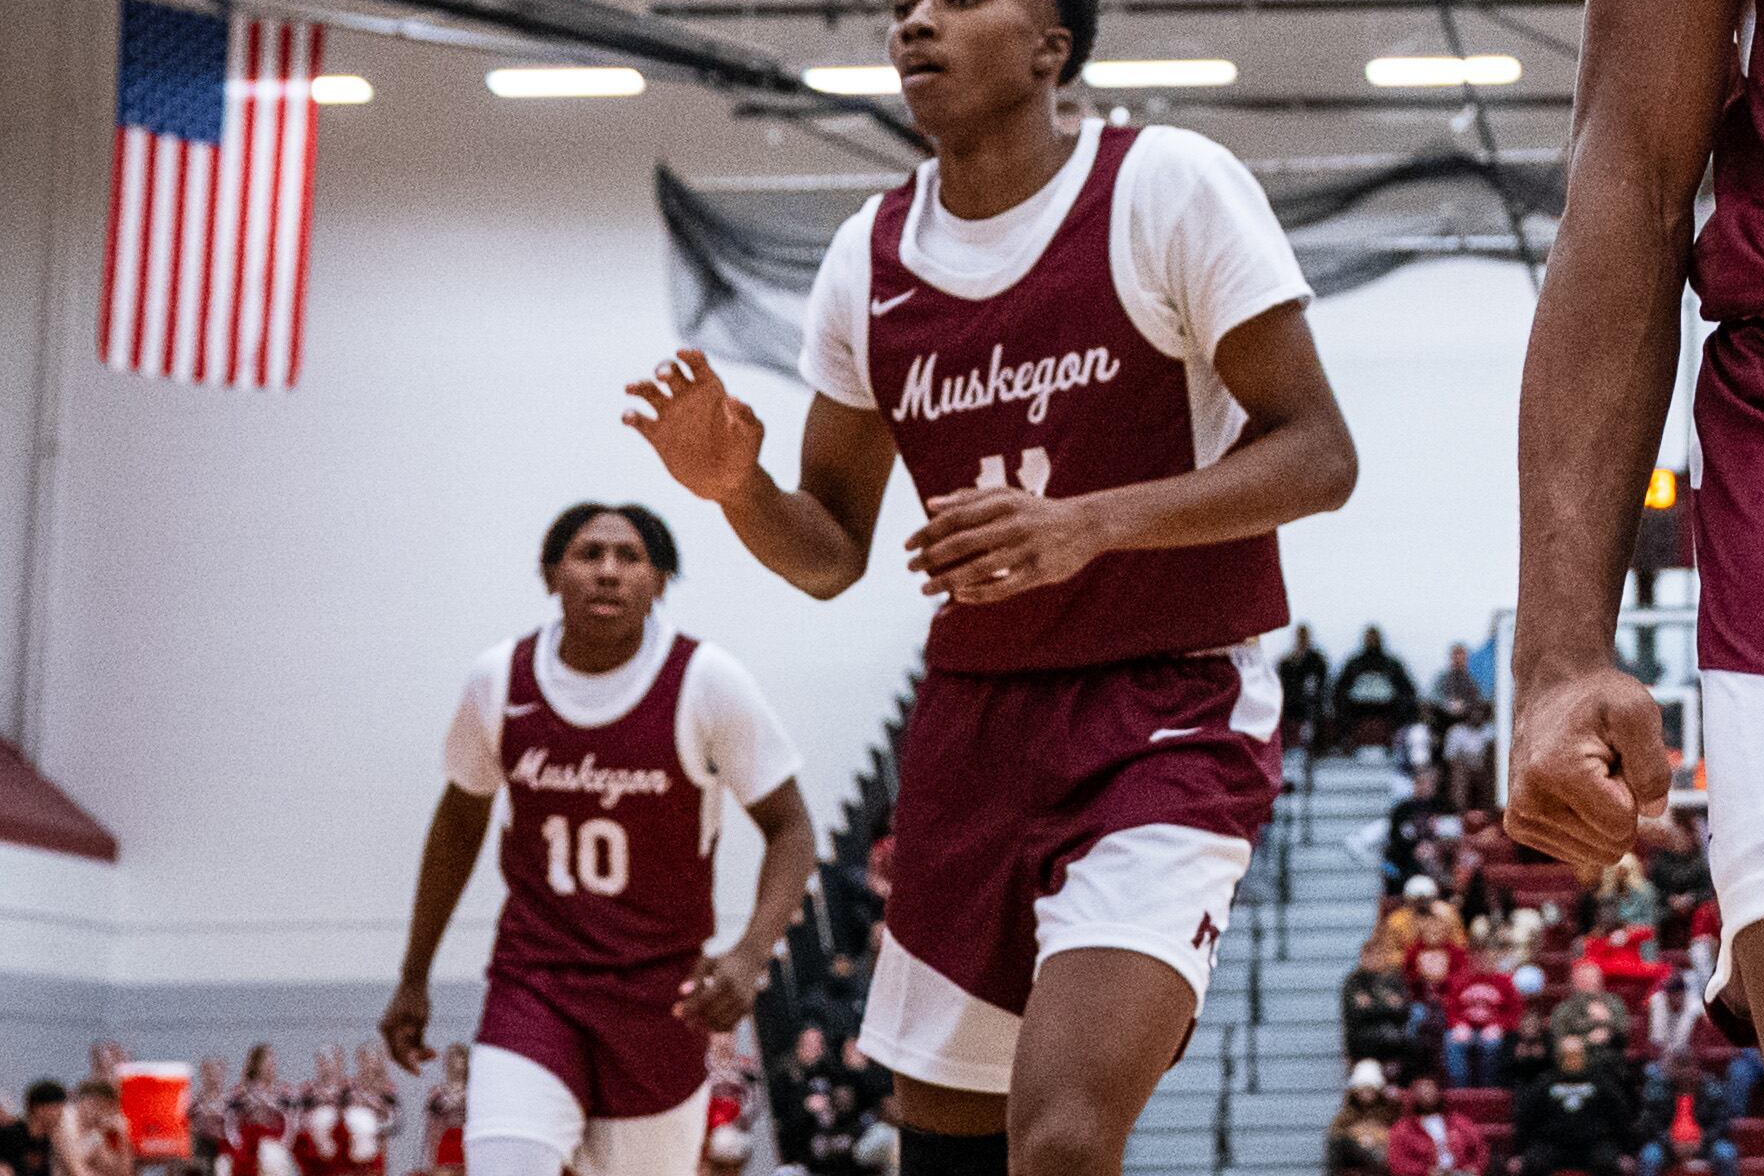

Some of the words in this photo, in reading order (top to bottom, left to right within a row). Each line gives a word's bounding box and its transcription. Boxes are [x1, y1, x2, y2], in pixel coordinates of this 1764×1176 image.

[893, 343, 1121, 424] Muskegon
[511, 746, 672, 810] Muskegon
[542, 814, 630, 898] 10
